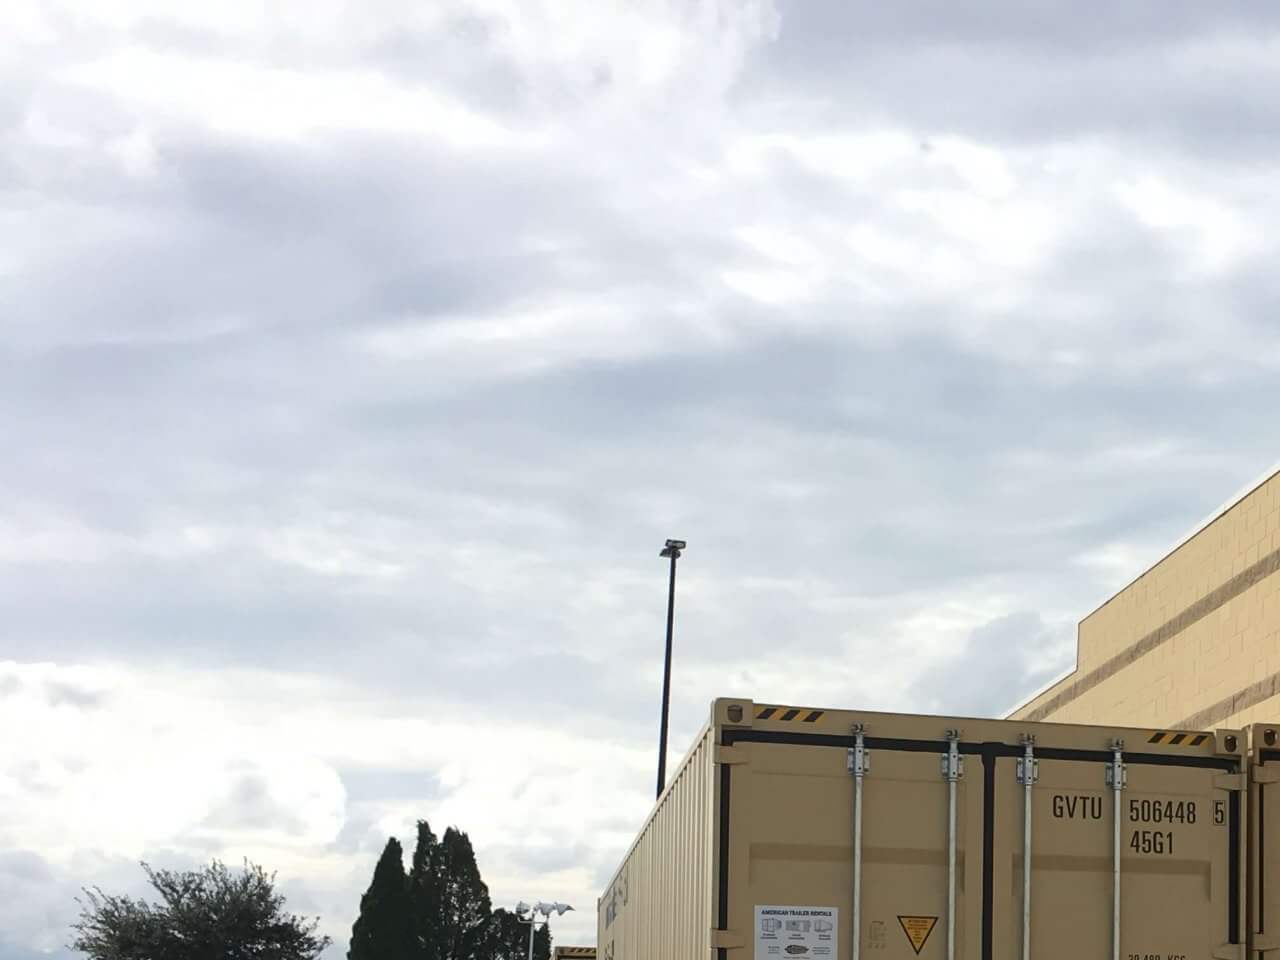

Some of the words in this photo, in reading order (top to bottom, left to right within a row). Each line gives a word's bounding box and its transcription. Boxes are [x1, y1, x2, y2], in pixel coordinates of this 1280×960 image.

[1052, 795, 1102, 820] GVTU
[1129, 799, 1197, 824] 506448
[1130, 830, 1174, 855] 45G1
